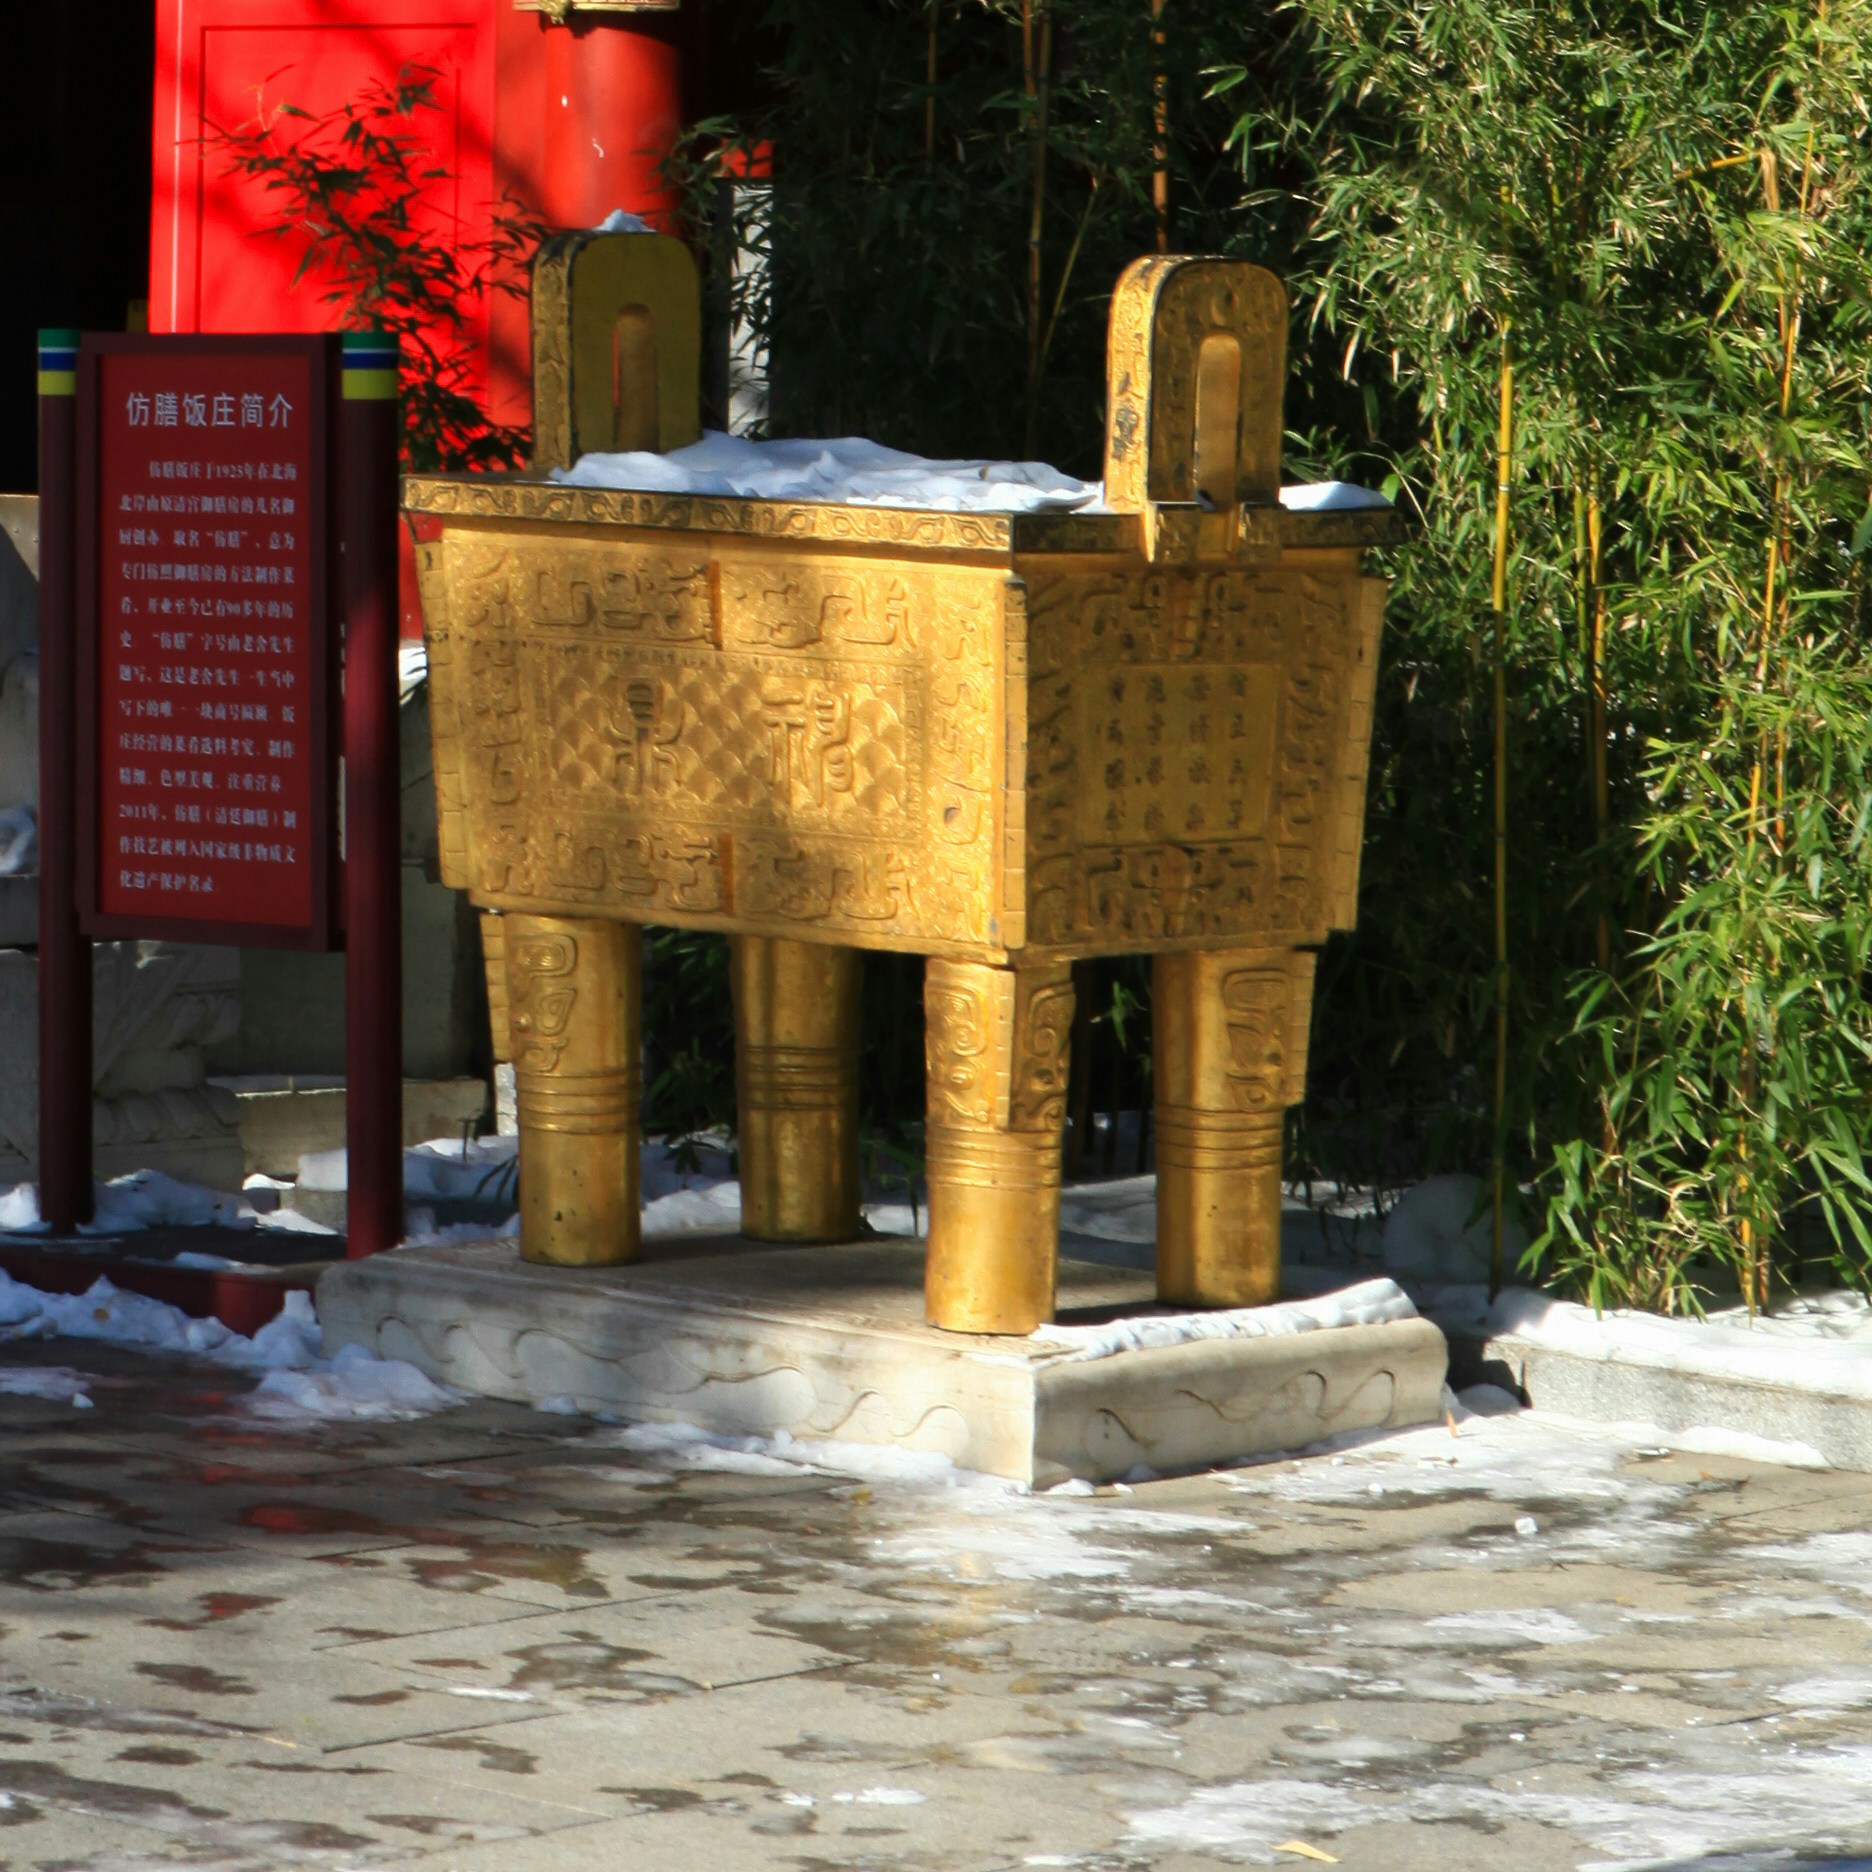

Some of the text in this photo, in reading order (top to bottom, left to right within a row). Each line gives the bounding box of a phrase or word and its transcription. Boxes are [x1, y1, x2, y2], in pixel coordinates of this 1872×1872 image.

[126, 391, 294, 429] 仿膳饭庄简介
